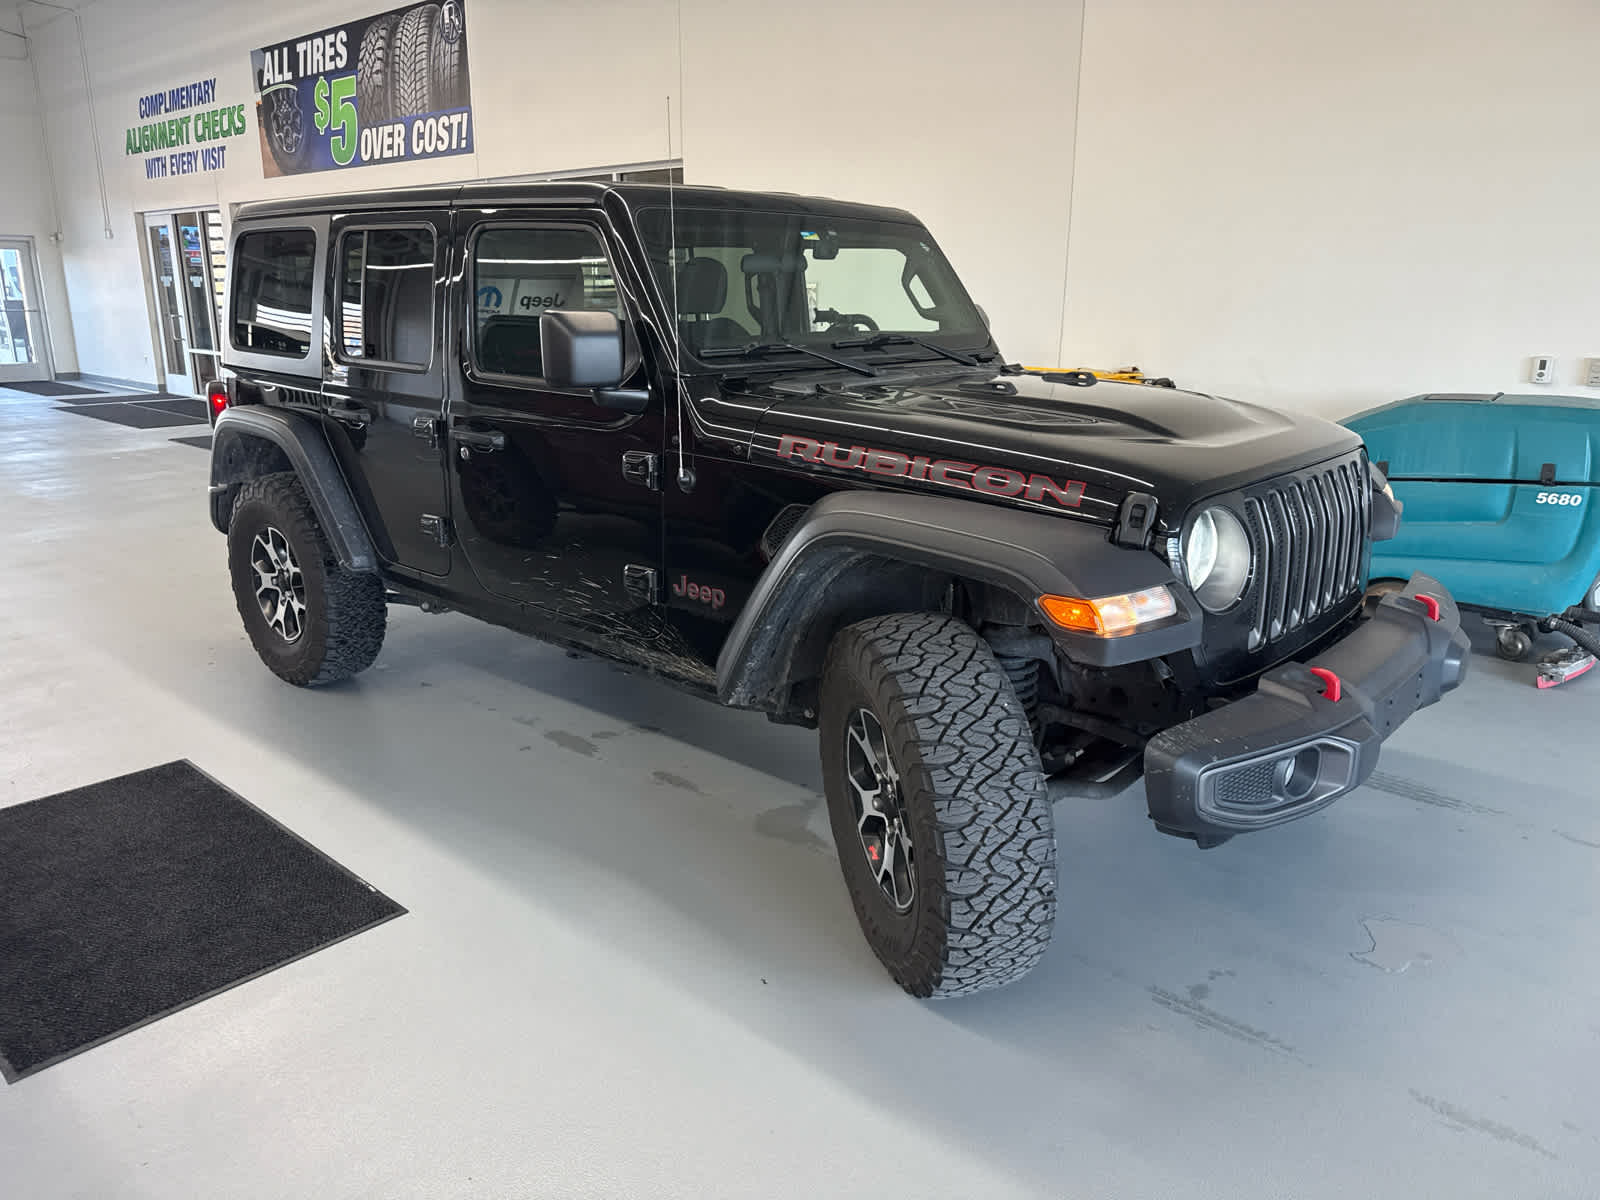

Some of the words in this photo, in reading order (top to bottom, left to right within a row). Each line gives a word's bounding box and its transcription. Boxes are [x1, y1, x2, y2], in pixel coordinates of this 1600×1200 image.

[262, 47, 293, 86] ALL
[296, 30, 348, 77] TIRES
[139, 78, 217, 119] COMPLIMENTARY
[314, 75, 358, 166] $5
[126, 115, 191, 155] ALIGNMENT
[193, 103, 246, 143] CHECKS
[360, 123, 406, 162] OVER
[412, 112, 469, 155] COST!
[145, 155, 167, 180] WITH
[170, 150, 199, 176] EVERY
[201, 145, 226, 171] VISIT
[776, 433, 1087, 507] RUBICON
[1535, 492, 1582, 506] 5680
[672, 574, 727, 609] Jeep
